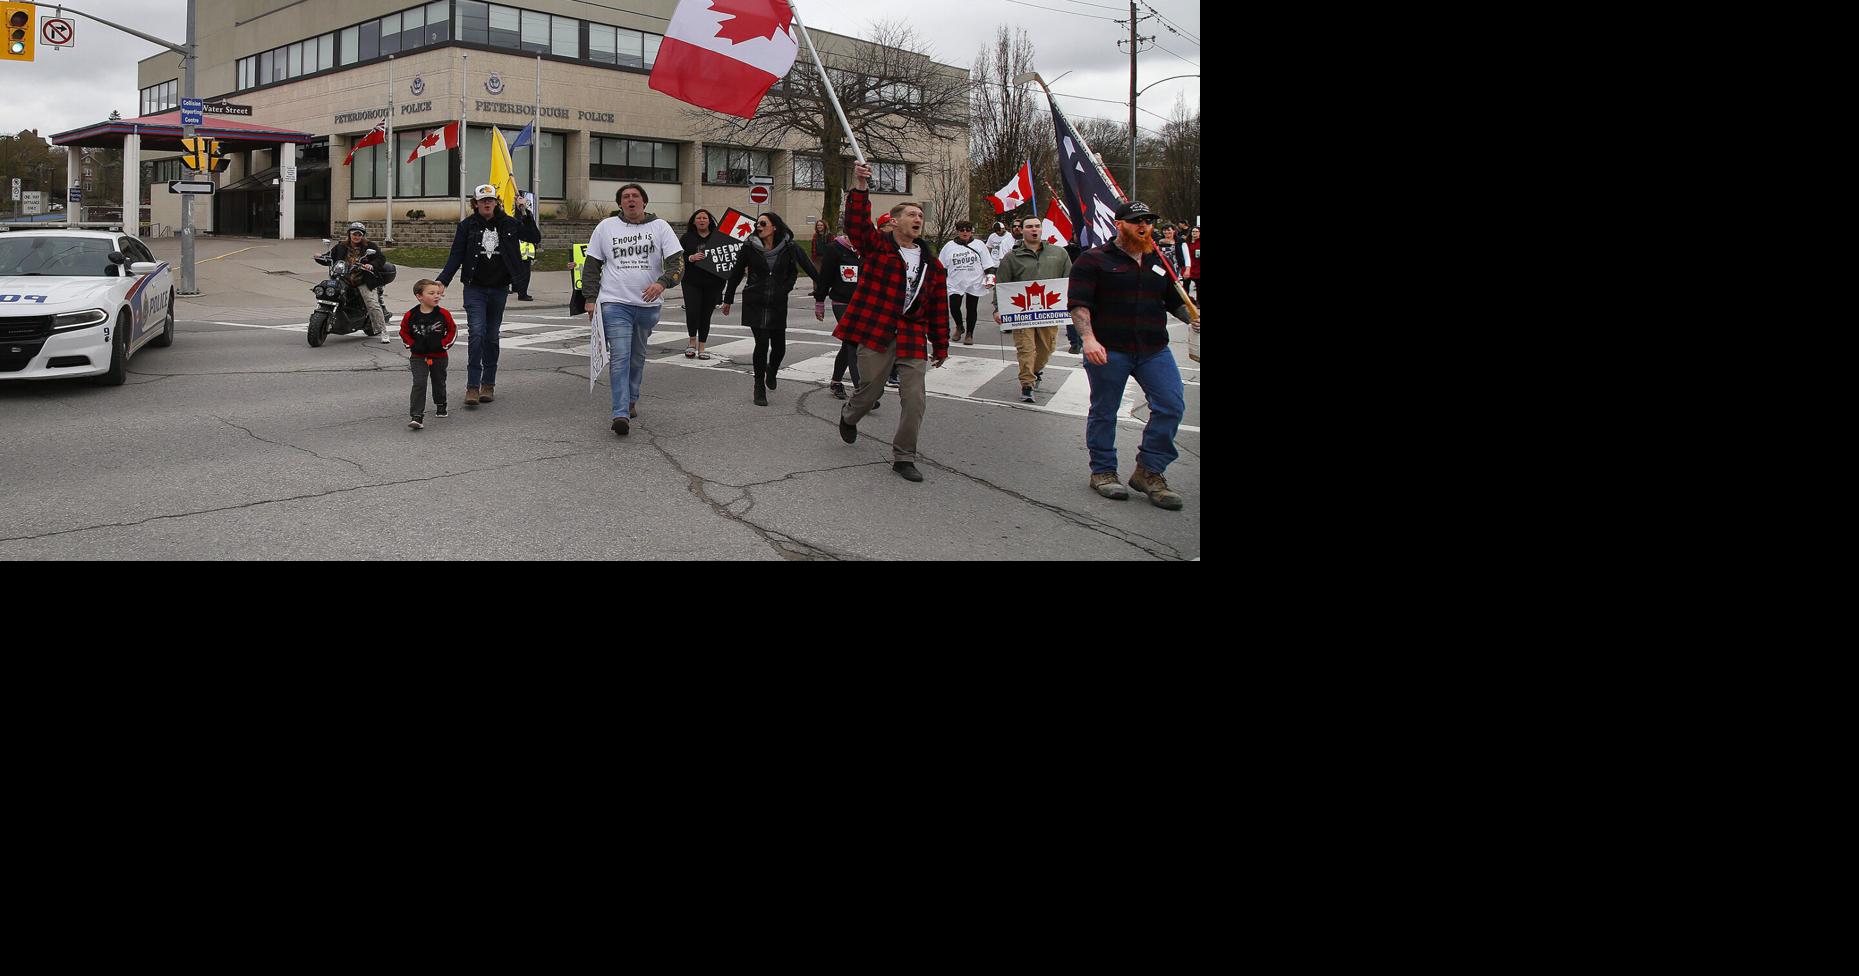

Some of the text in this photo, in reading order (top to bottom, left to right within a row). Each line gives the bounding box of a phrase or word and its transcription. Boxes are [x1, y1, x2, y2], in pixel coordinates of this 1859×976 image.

[225, 106, 248, 115] Street
[401, 101, 432, 115] POLICE
[475, 100, 615, 123] PETERBOROUGH POLICE
[612, 232, 652, 246] Enough is
[612, 240, 655, 259] Enough
[712, 252, 737, 263] OVER
[952, 254, 979, 266] Enough
[715, 261, 737, 273] FEA
